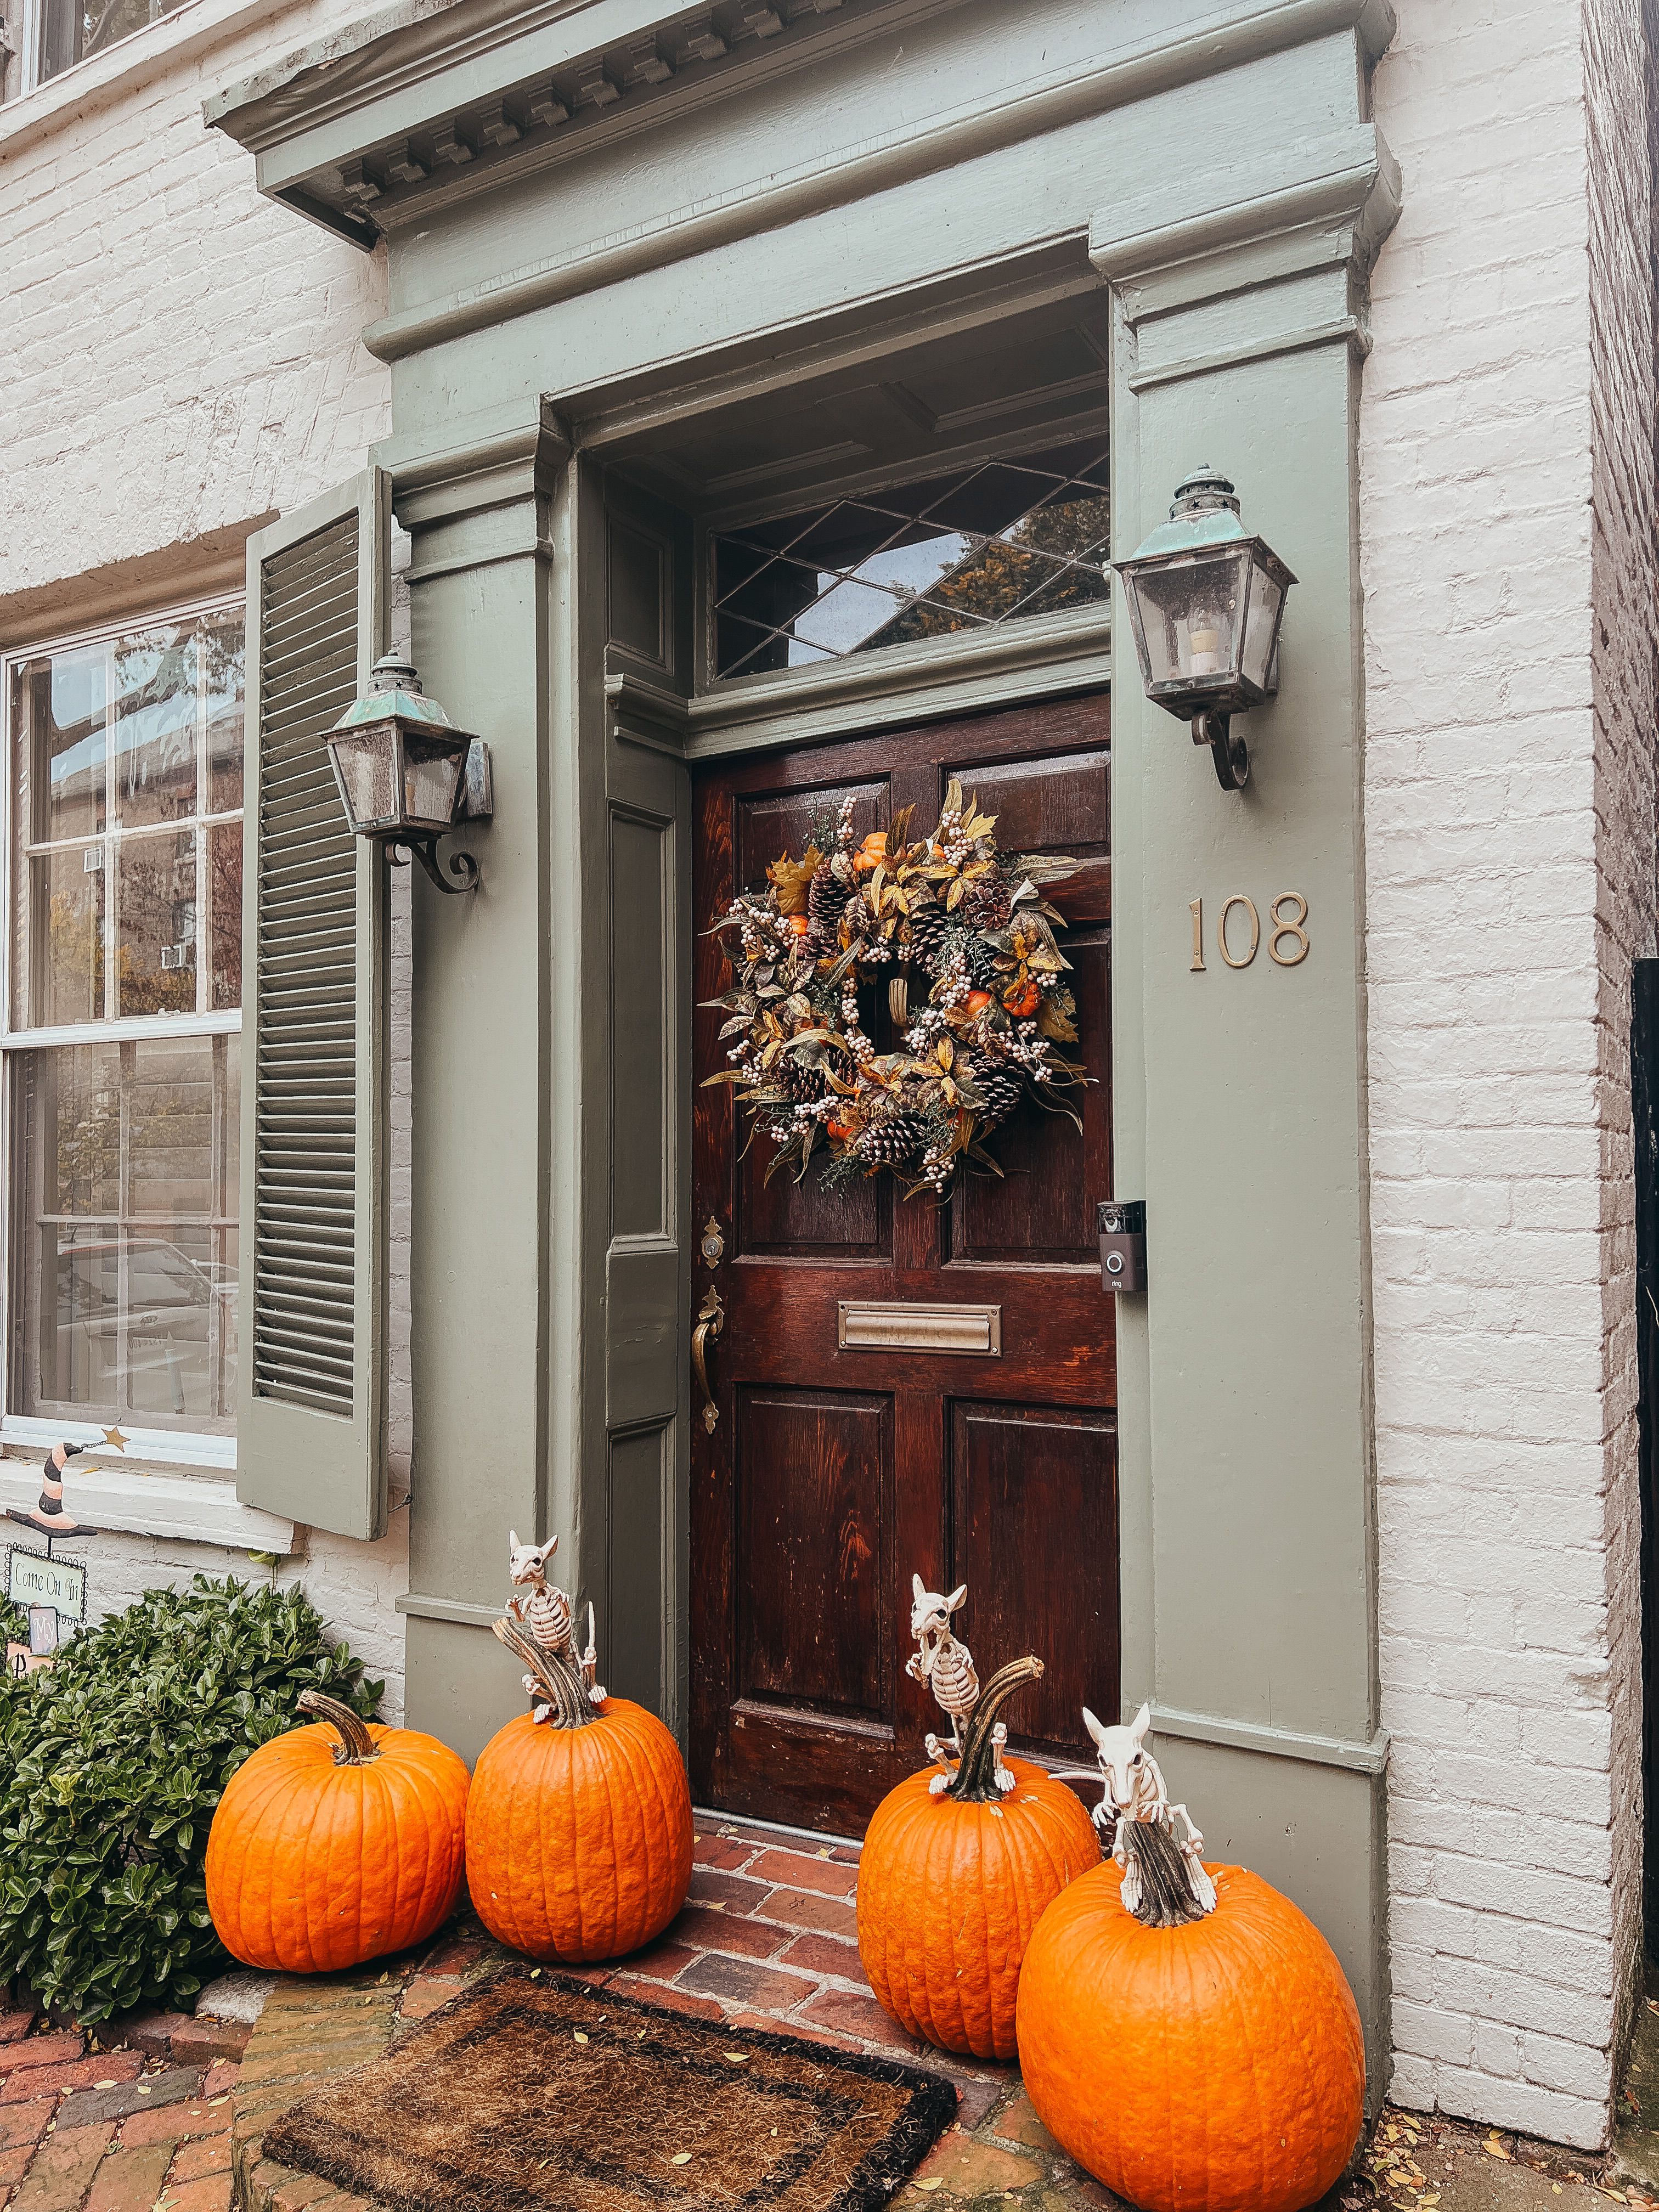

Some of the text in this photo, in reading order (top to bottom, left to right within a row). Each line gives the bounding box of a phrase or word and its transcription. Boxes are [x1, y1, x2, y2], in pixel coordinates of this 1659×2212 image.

[1189, 890, 1310, 972] 108
[15, 1562, 78, 1601] Come On In
[33, 1616, 55, 1644] My
